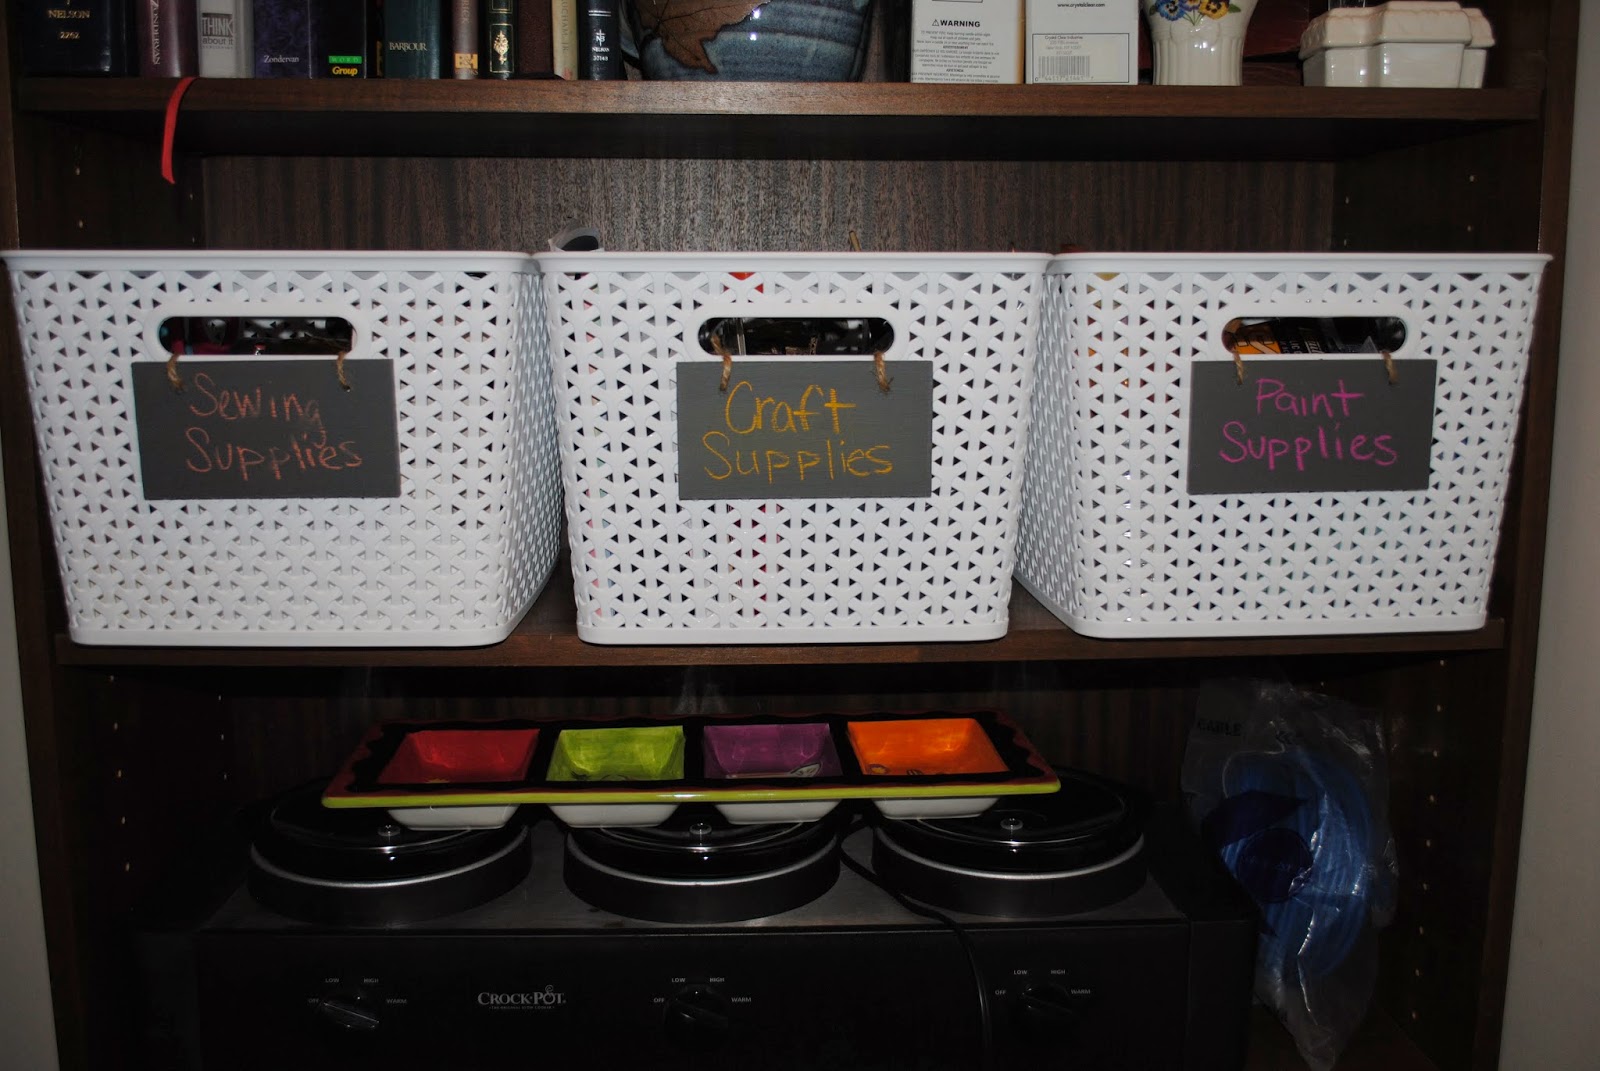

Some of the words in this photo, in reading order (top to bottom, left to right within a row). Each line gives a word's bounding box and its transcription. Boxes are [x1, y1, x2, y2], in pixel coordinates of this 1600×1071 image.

[48, 9, 91, 19] NELSON
[939, 19, 981, 28] WARNING
[202, 16, 235, 36] THINK
[202, 37, 227, 46] about
[228, 37, 234, 46] it
[389, 42, 428, 52] BARBOUR
[263, 54, 300, 64] Zondervan
[332, 66, 359, 77] Group
[724, 380, 857, 435] Craft
[1255, 377, 1365, 418] Paint
[189, 372, 328, 448] Sewing
[184, 426, 363, 481] Supplies
[1218, 420, 1398, 472] Supplies
[701, 430, 894, 485] Supplies
